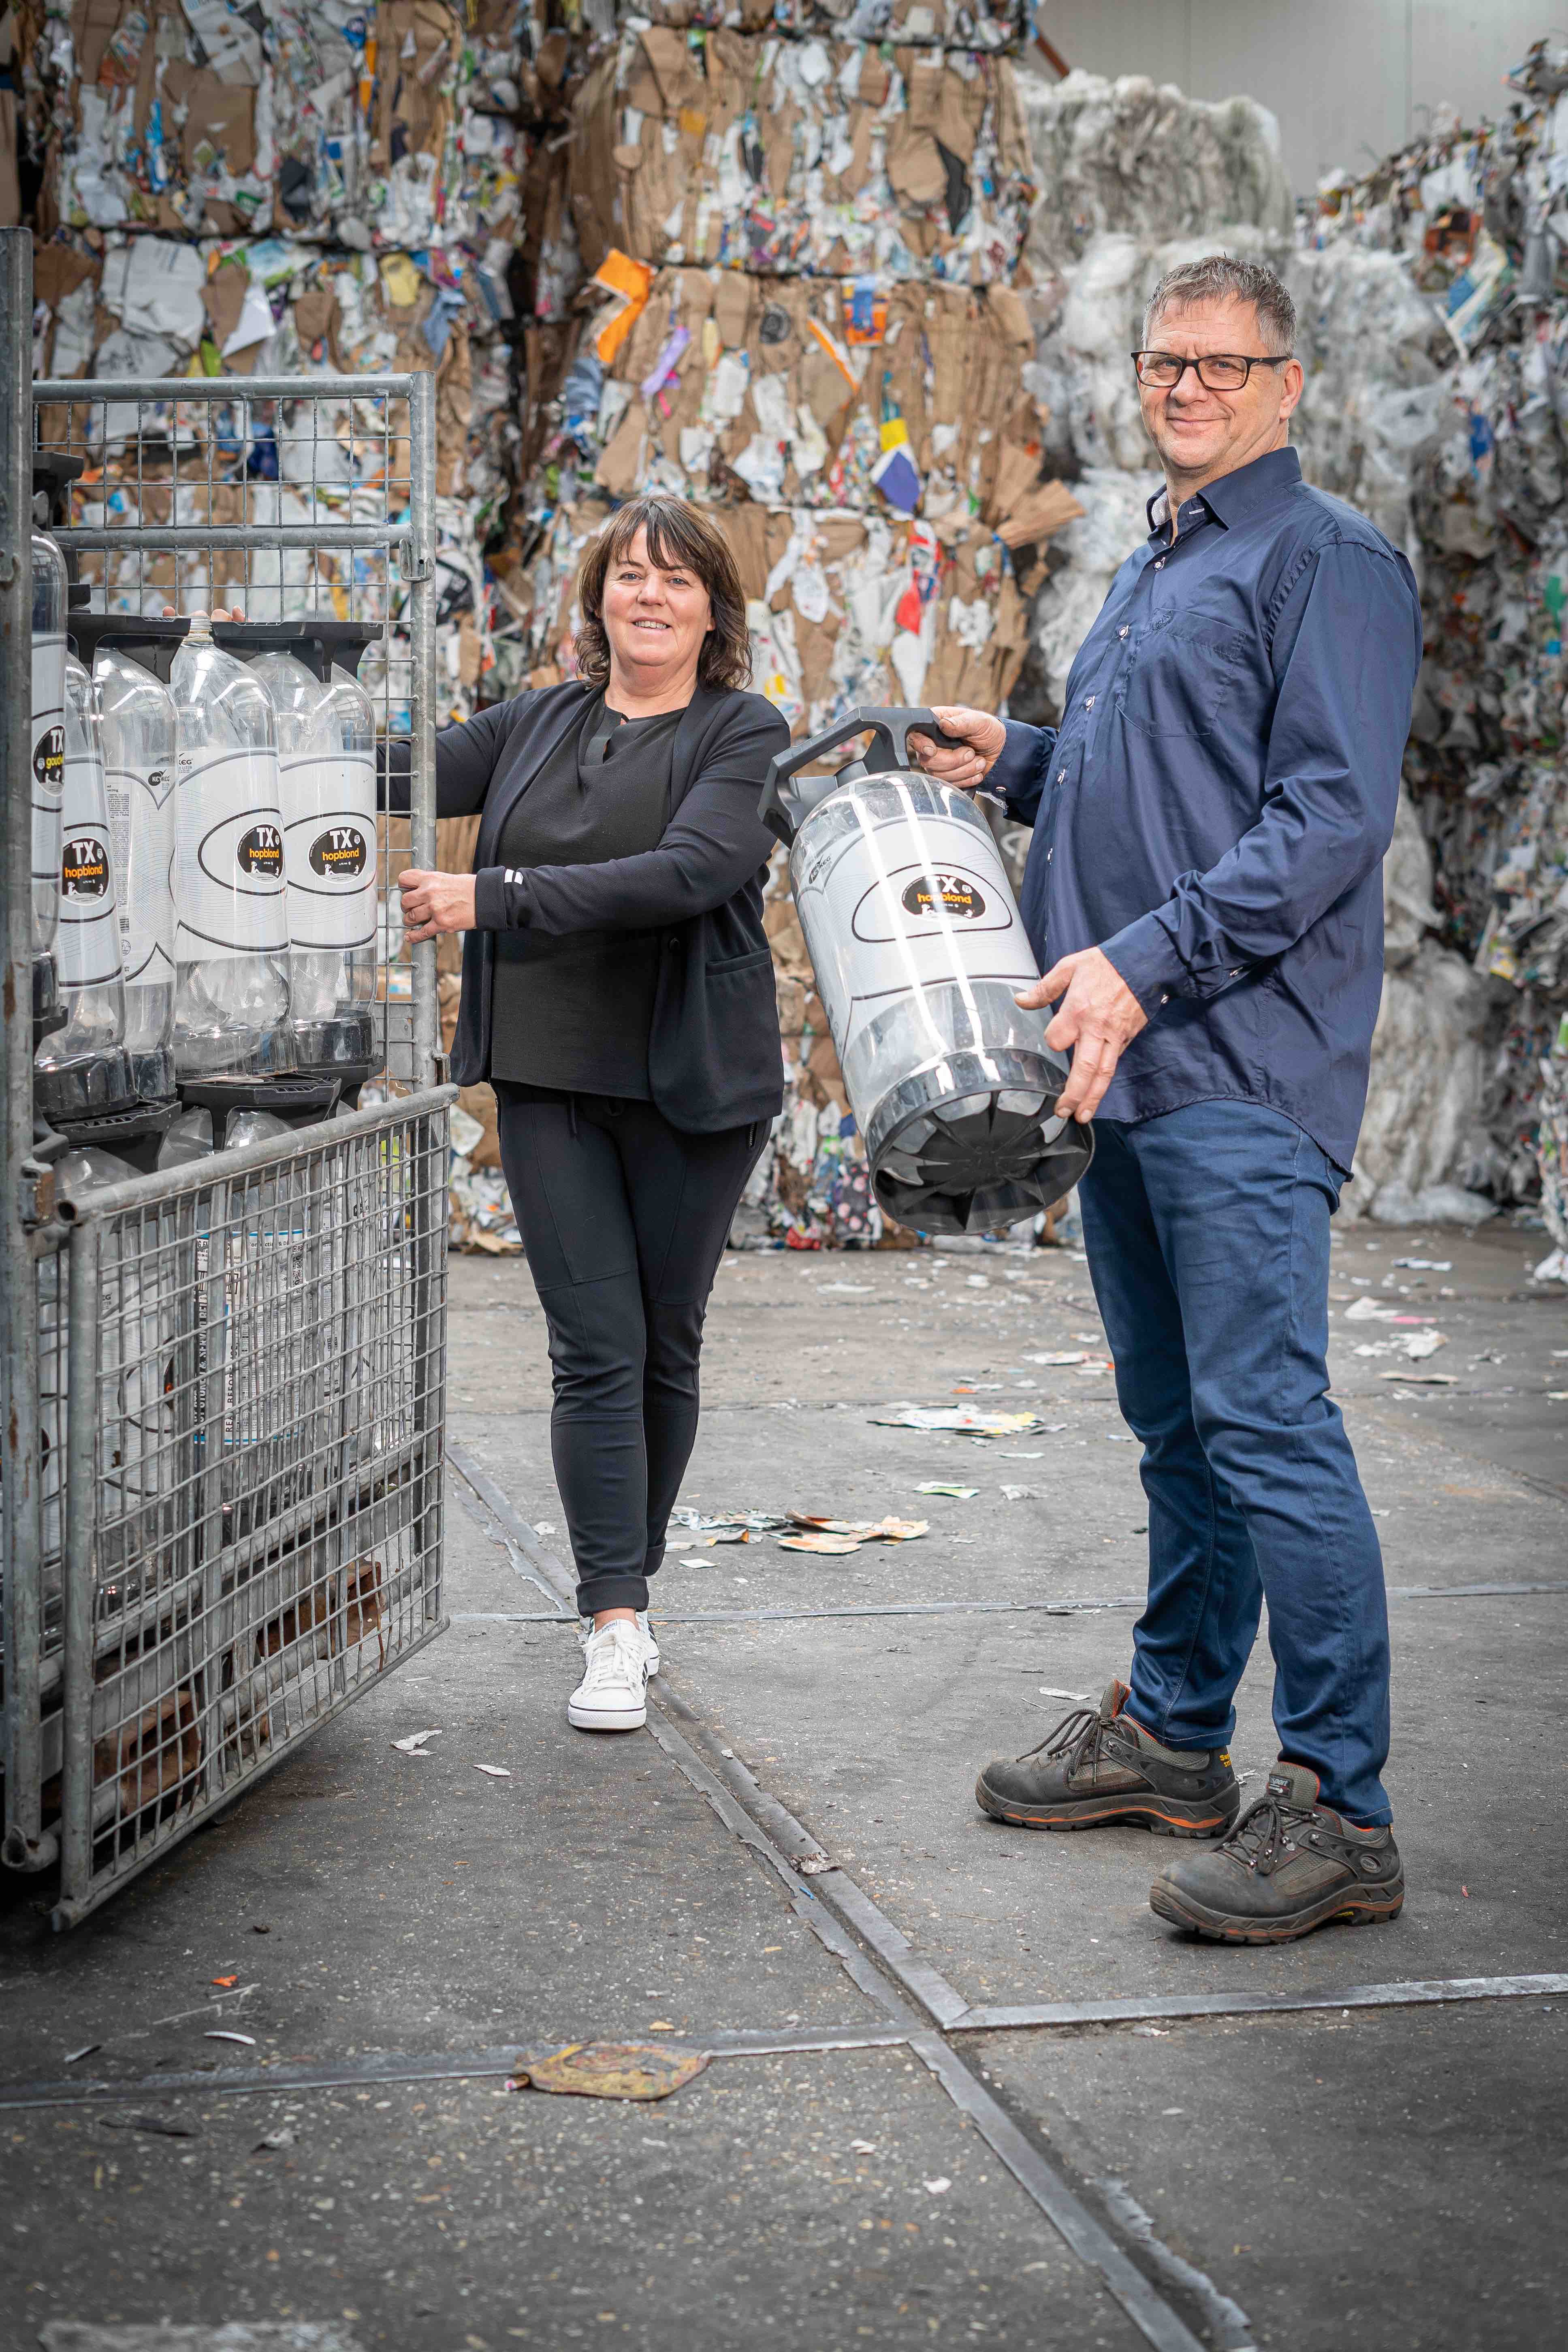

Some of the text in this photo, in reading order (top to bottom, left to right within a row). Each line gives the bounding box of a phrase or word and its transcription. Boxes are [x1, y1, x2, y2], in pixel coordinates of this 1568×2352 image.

[50, 729, 64, 753] TX
[256, 828, 275, 847] TX
[330, 829, 352, 849] TX
[72, 841, 96, 864] TX
[250, 848, 279, 860] hopblond
[322, 847, 359, 861] hopblond
[64, 864, 103, 879] hopblond
[926, 875, 960, 894] TX
